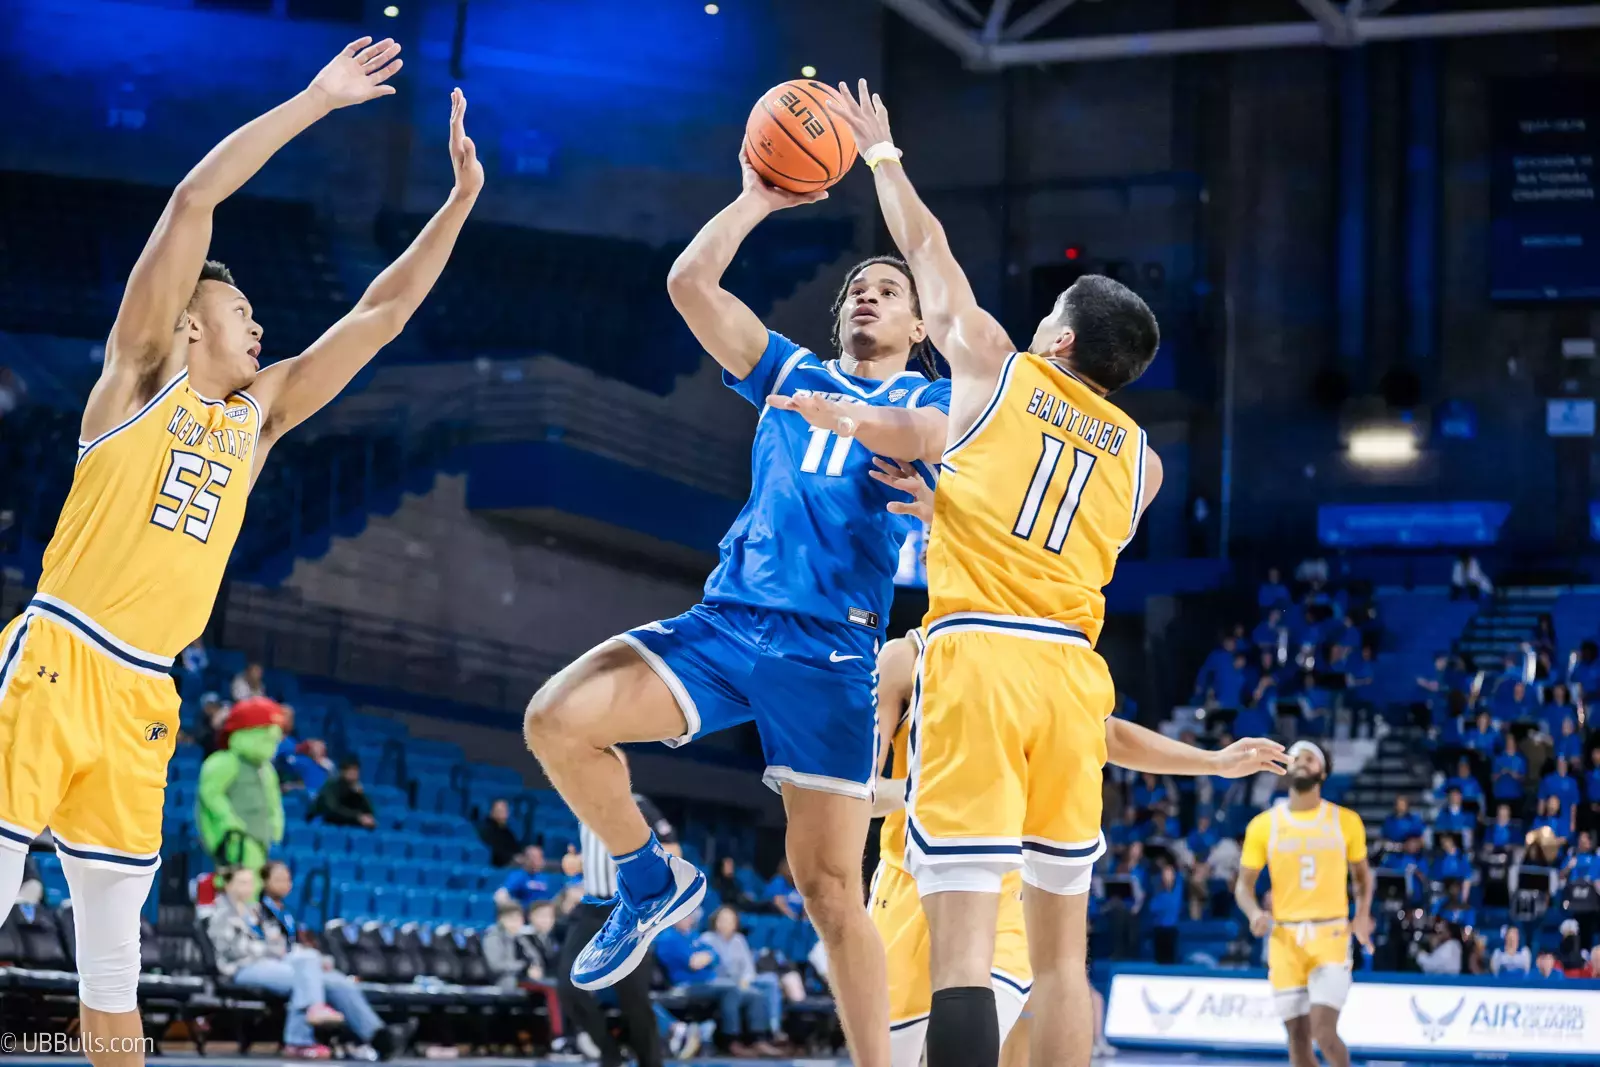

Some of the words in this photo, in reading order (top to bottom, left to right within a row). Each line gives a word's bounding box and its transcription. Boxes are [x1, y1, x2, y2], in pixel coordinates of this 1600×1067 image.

[780, 90, 825, 139] ELITE
[1026, 387, 1128, 457] SANTIAGO
[800, 425, 855, 477] 11
[149, 448, 232, 544] 55
[1011, 432, 1098, 556] 11
[1299, 854, 1316, 890] 2
[1470, 1000, 1521, 1028] AIR
